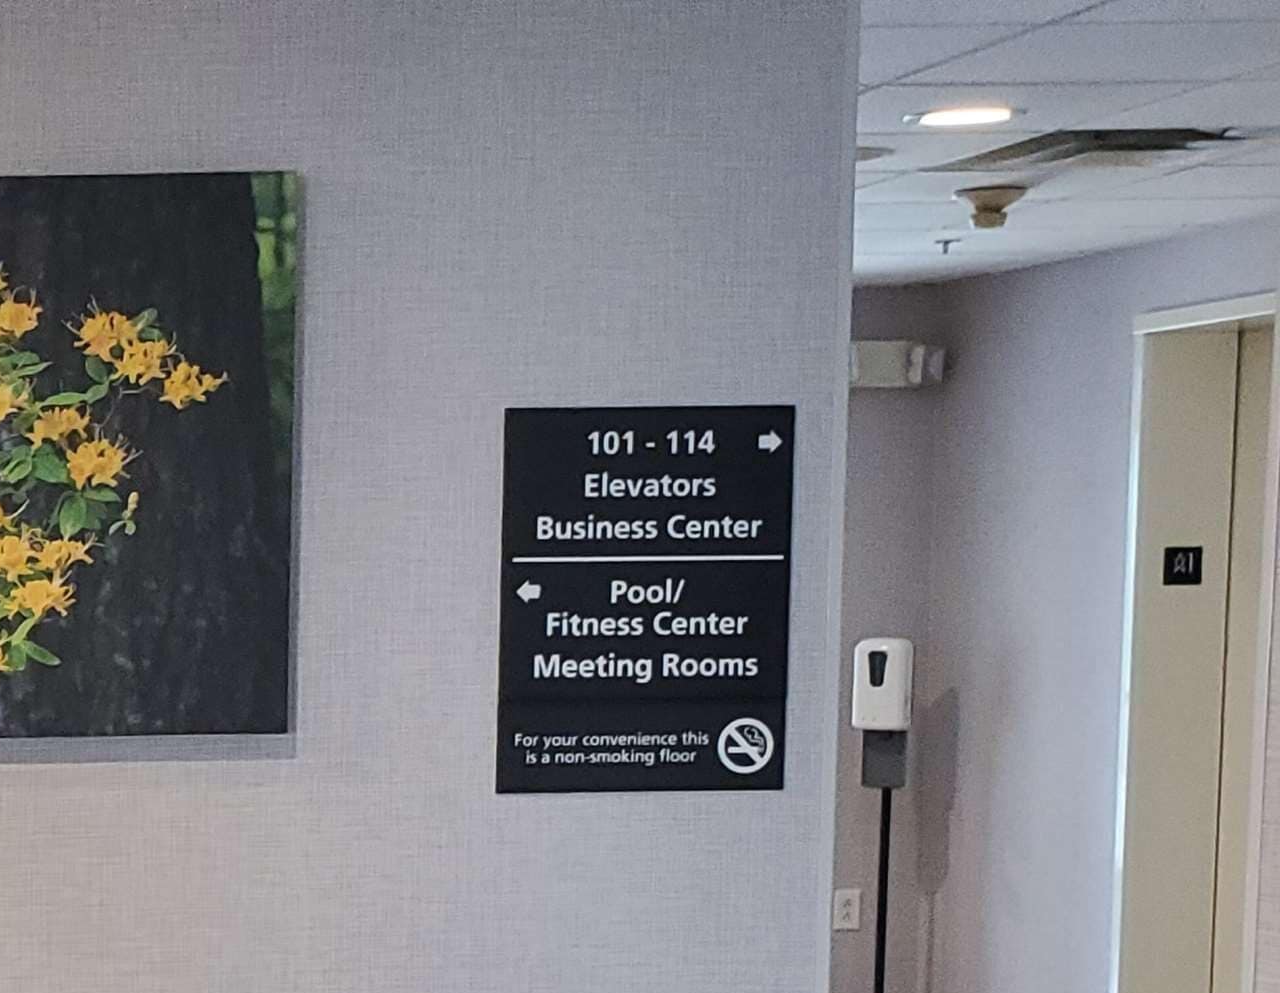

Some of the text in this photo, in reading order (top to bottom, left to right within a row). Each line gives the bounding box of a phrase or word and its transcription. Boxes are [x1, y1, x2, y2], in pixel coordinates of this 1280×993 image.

[587, 430, 635, 455] 101
[666, 429, 716, 455] 114
[584, 472, 717, 497] Elevators
[536, 514, 763, 540] Business Center
[610, 578, 686, 604] Pool/
[546, 610, 749, 637] Fitness Center
[533, 652, 759, 684] Meeting Rooms
[514, 730, 710, 750] For your convenience this
[525, 748, 697, 767] is a non-smoking floor
